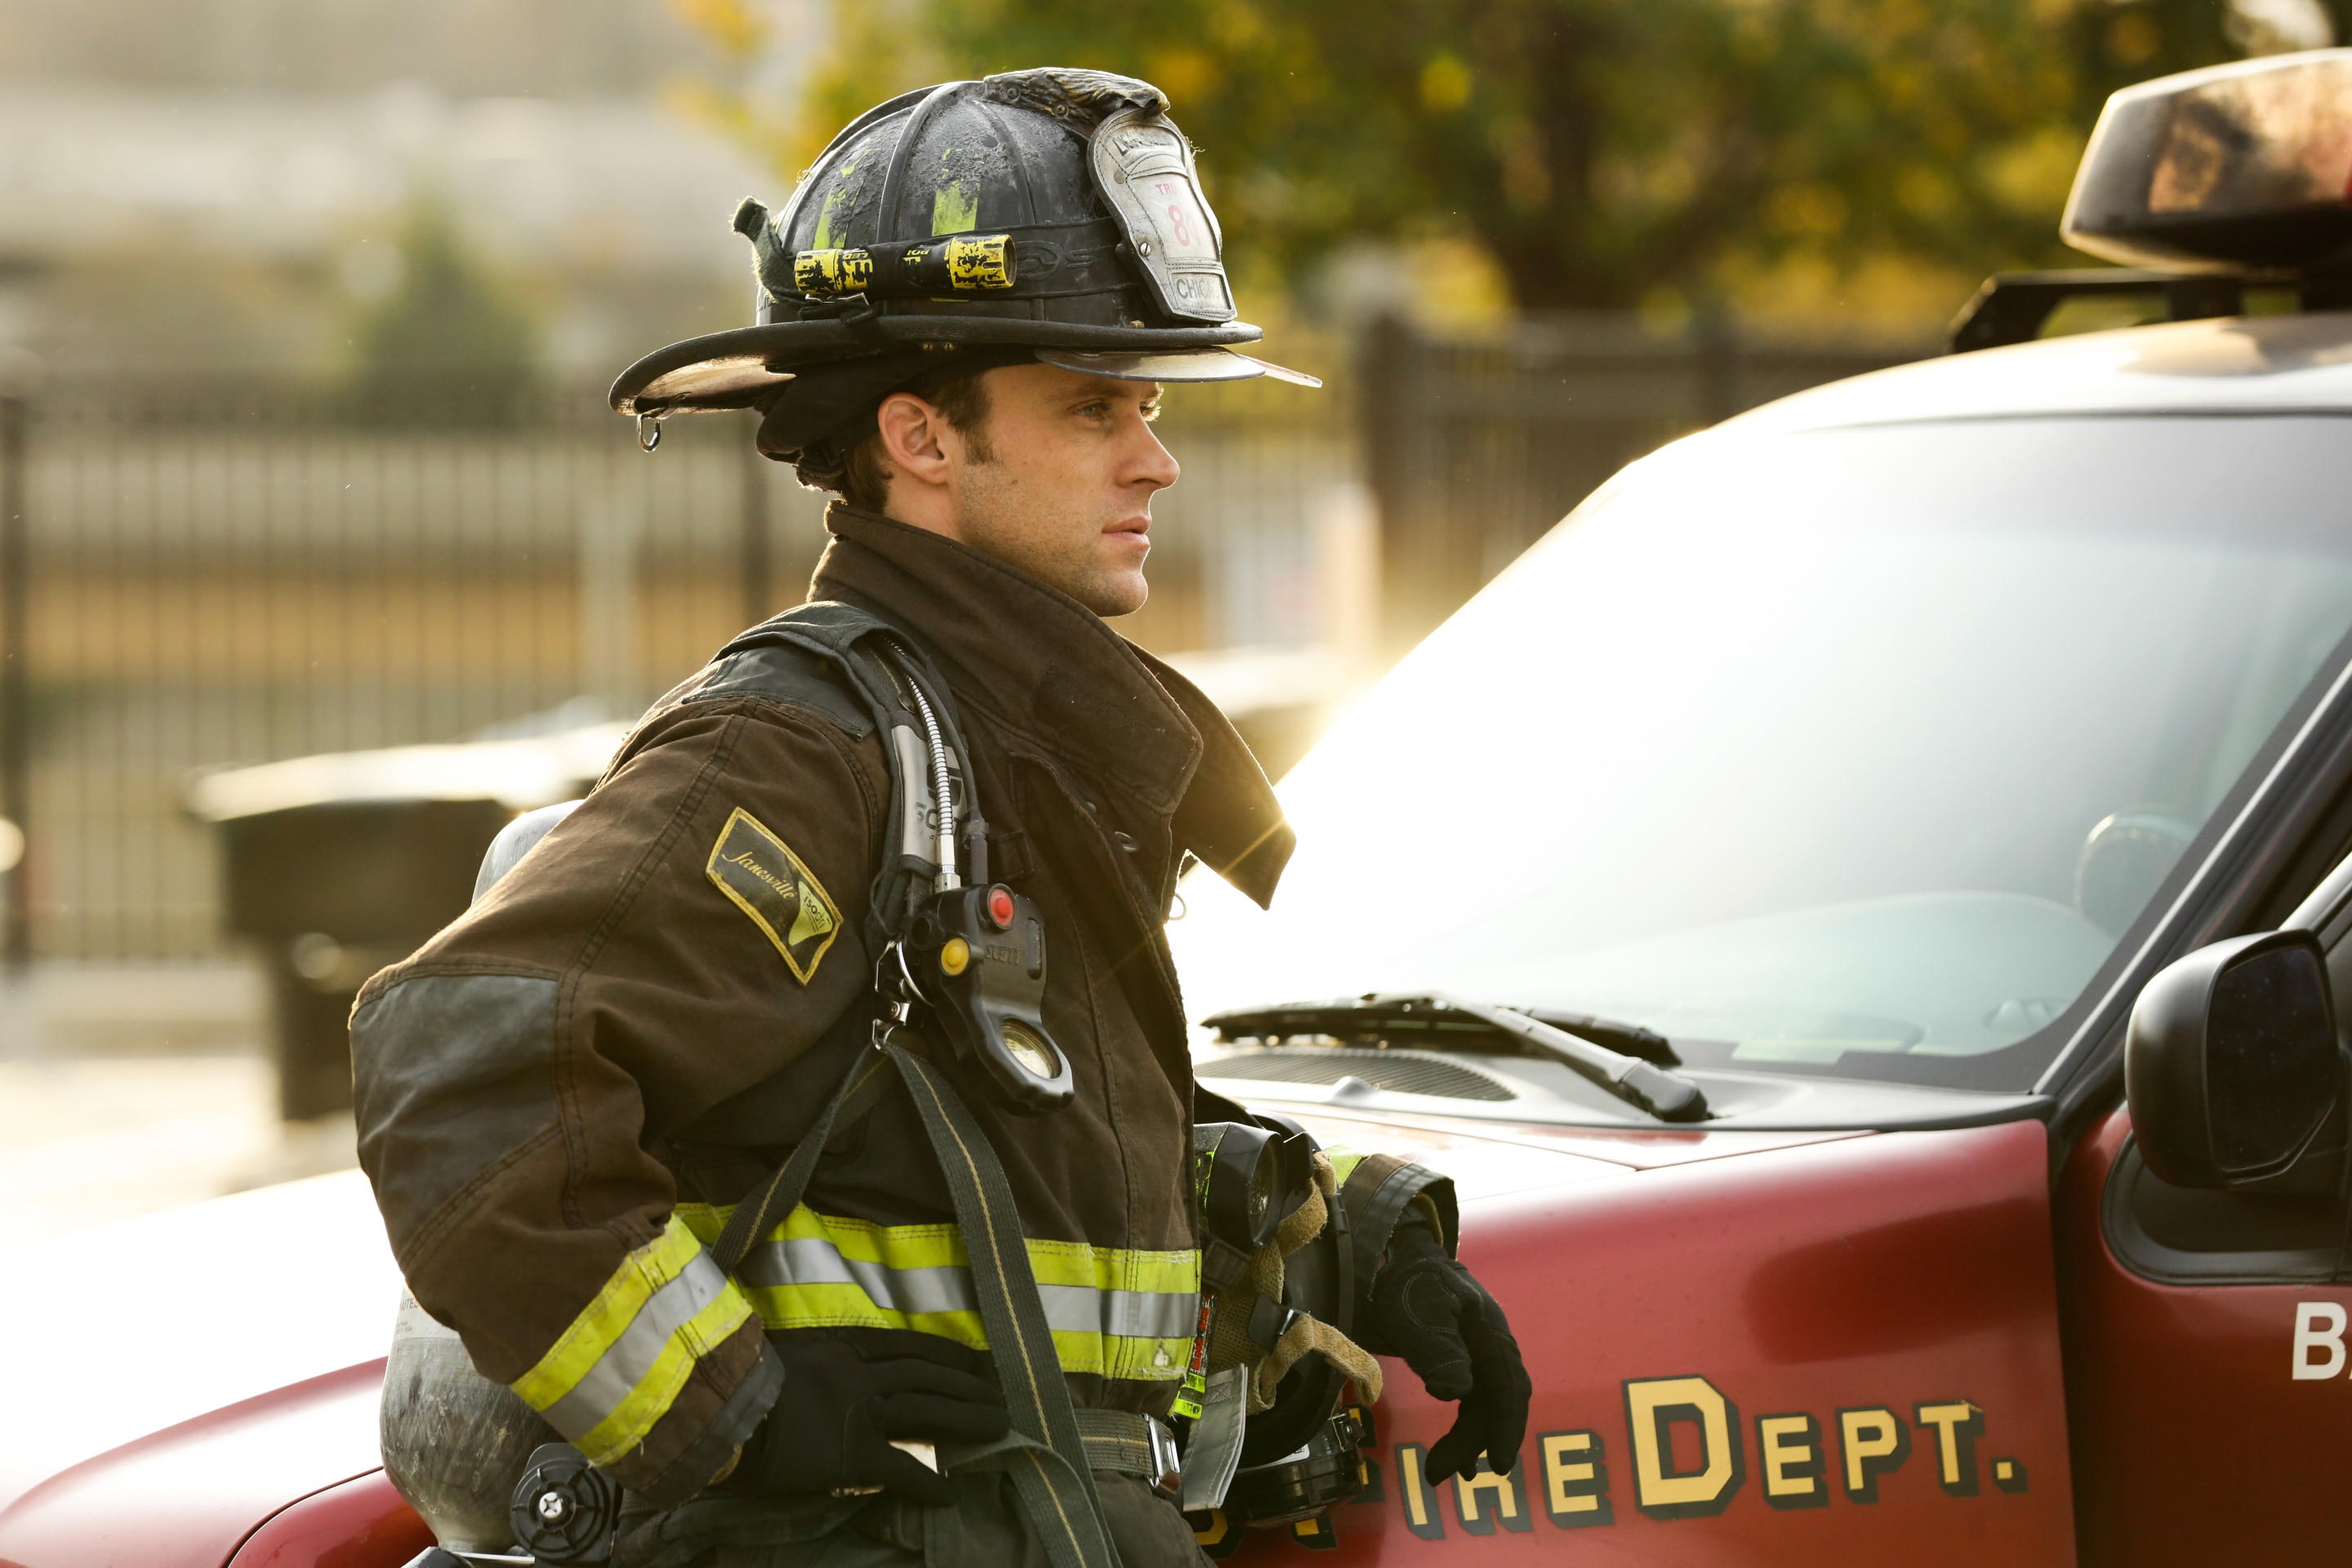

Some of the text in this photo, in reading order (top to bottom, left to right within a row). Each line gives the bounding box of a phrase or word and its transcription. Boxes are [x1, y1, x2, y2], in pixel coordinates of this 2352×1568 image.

[722, 851, 795, 899] Janesville
[2292, 1302, 2352, 1381] B
[1624, 1375, 2023, 1516] DEPT.
